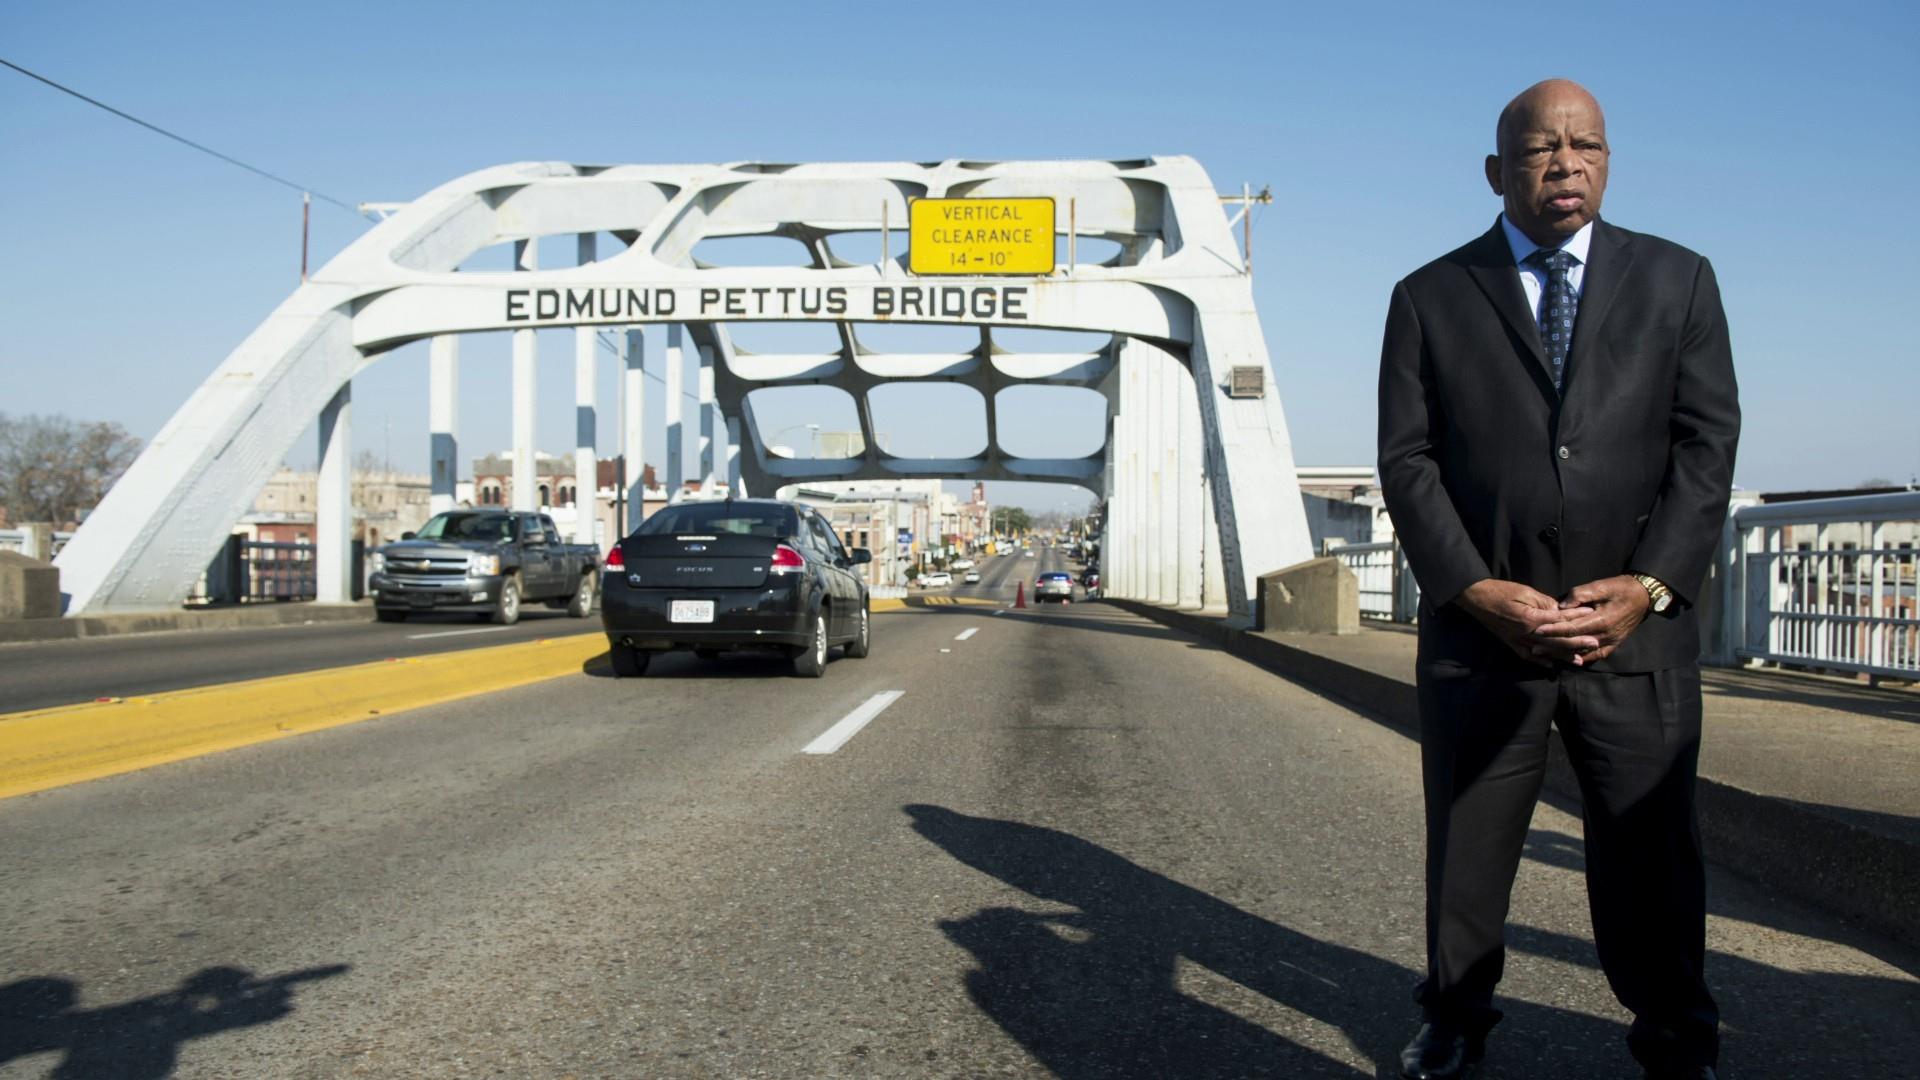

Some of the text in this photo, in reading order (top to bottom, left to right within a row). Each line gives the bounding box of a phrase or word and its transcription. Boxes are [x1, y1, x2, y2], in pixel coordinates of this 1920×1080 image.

[942, 206, 1023, 221] VERTICAL
[932, 229, 1033, 244] CLEARANCE
[506, 287, 1028, 321] EDMUND PETTUS BRIDGE
